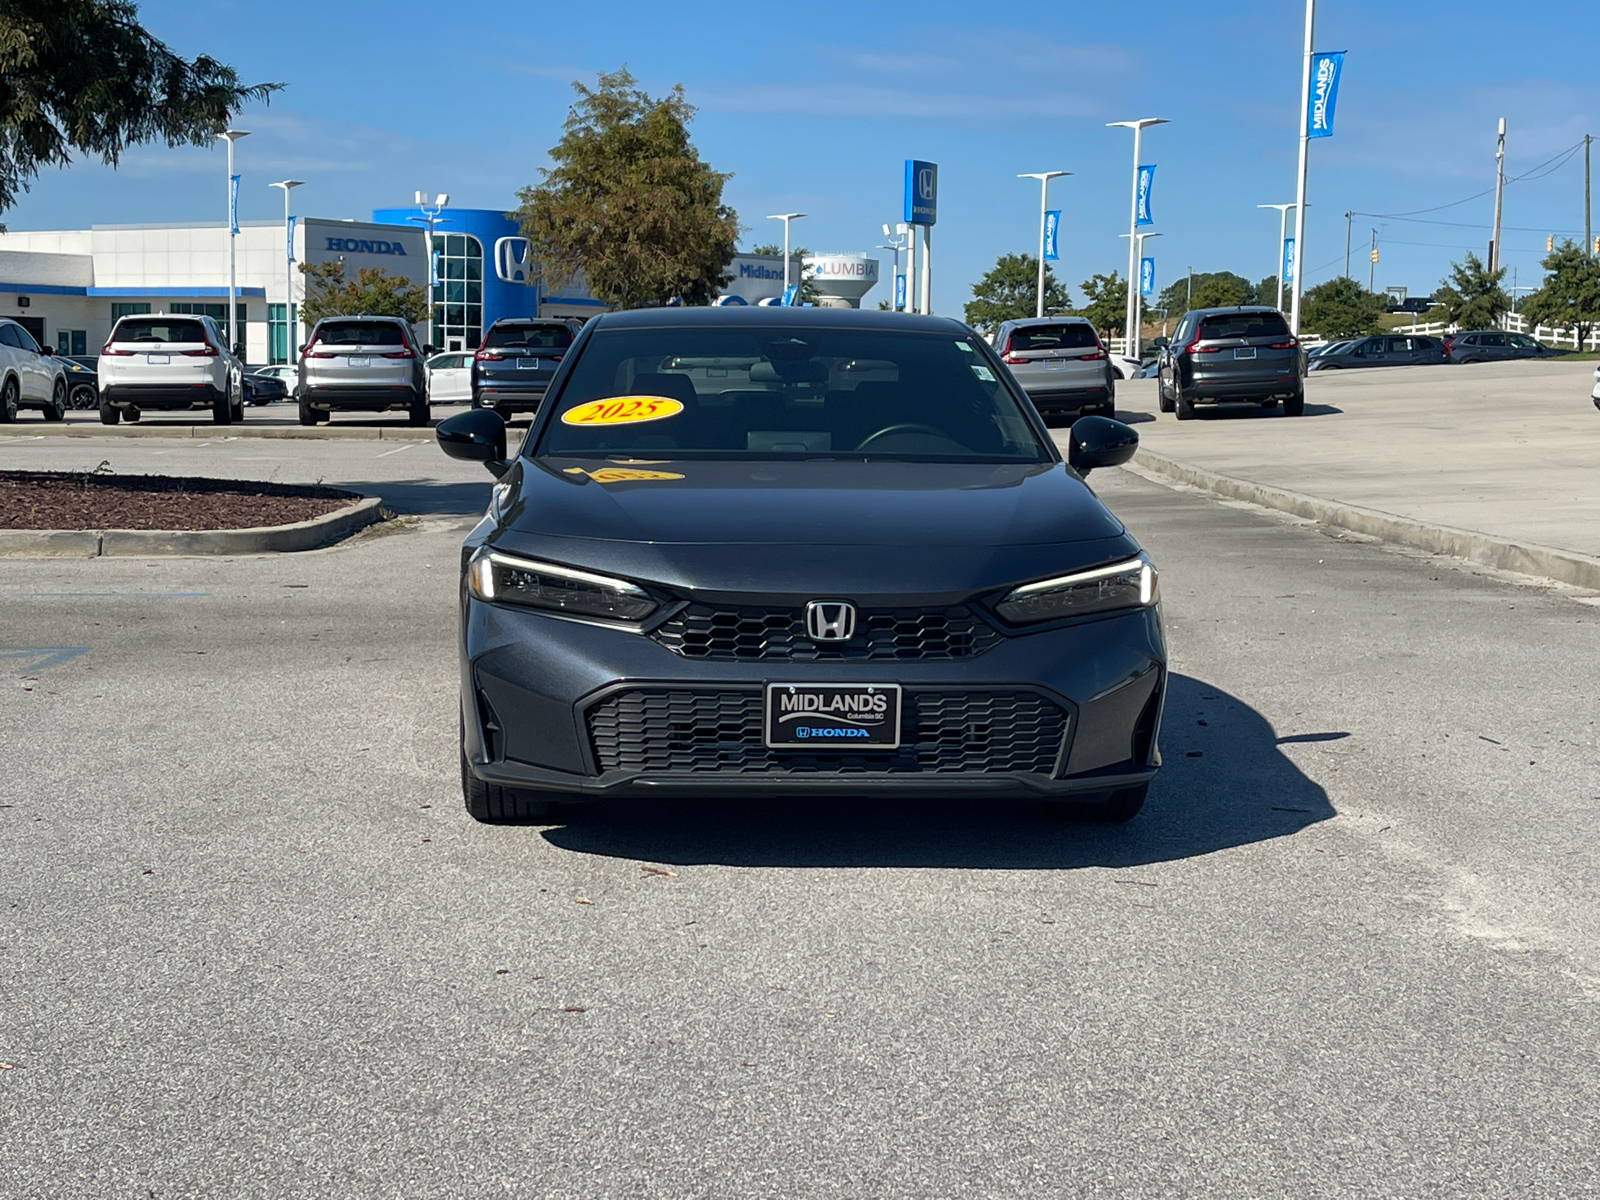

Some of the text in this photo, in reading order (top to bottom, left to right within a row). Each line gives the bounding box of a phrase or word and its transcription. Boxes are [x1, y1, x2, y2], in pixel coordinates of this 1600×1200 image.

[1313, 58, 1330, 129] MIDLANDS
[1139, 169, 1148, 219] MIDLANDS
[1047, 214, 1055, 255] MIDLANDS
[326, 237, 407, 255] HONDA
[740, 263, 791, 281] Midland
[579, 400, 664, 422] 2025
[780, 694, 887, 712] MIDLANDS
[811, 728, 870, 737] HONDA
